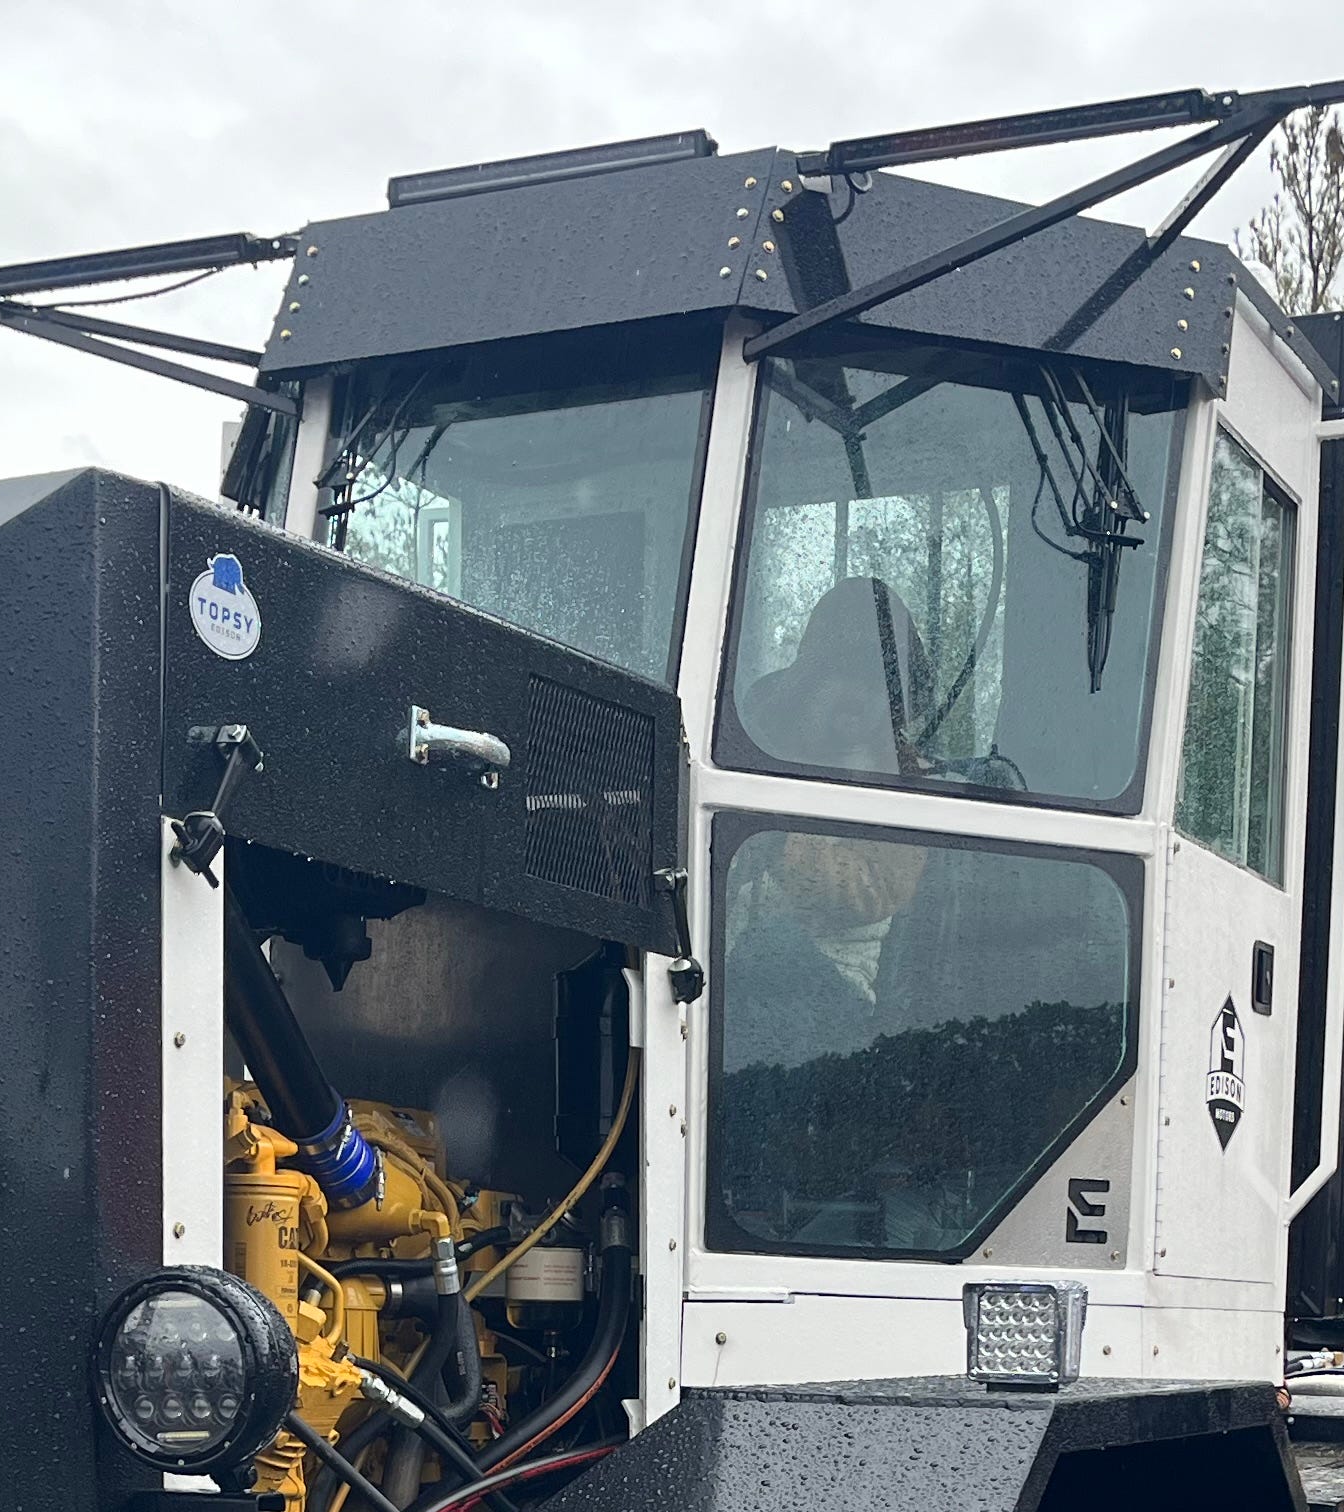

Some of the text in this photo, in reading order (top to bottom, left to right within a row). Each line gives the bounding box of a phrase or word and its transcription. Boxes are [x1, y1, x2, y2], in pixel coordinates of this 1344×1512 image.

[197, 596, 254, 634] TOPSY
[1210, 1075, 1242, 1103] EDISON
[278, 1225, 300, 1250] CA
